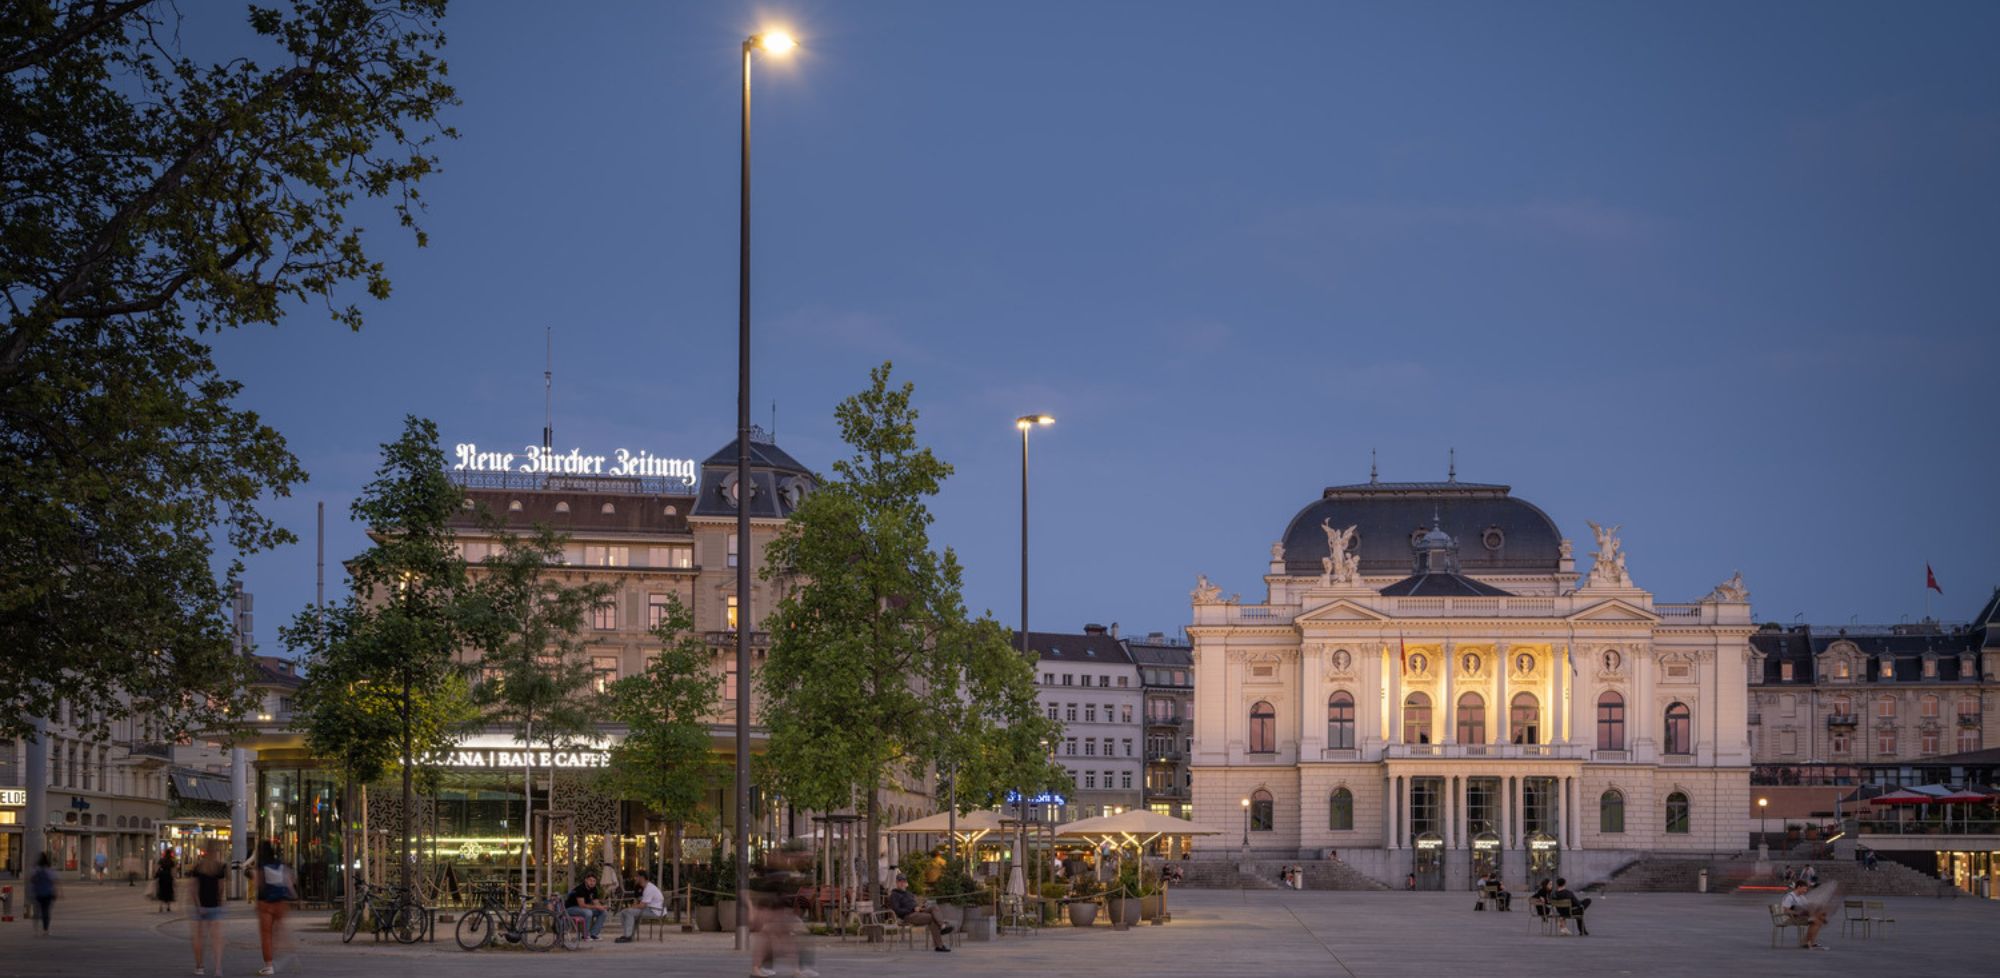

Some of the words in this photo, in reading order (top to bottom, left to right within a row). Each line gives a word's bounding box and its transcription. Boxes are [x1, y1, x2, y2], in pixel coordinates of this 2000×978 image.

[454, 443, 513, 471] Neue
[519, 445, 605, 475] Zürcher
[609, 448, 697, 486] Zeitung
[499, 751, 536, 767] BAR
[539, 752, 551, 767] E
